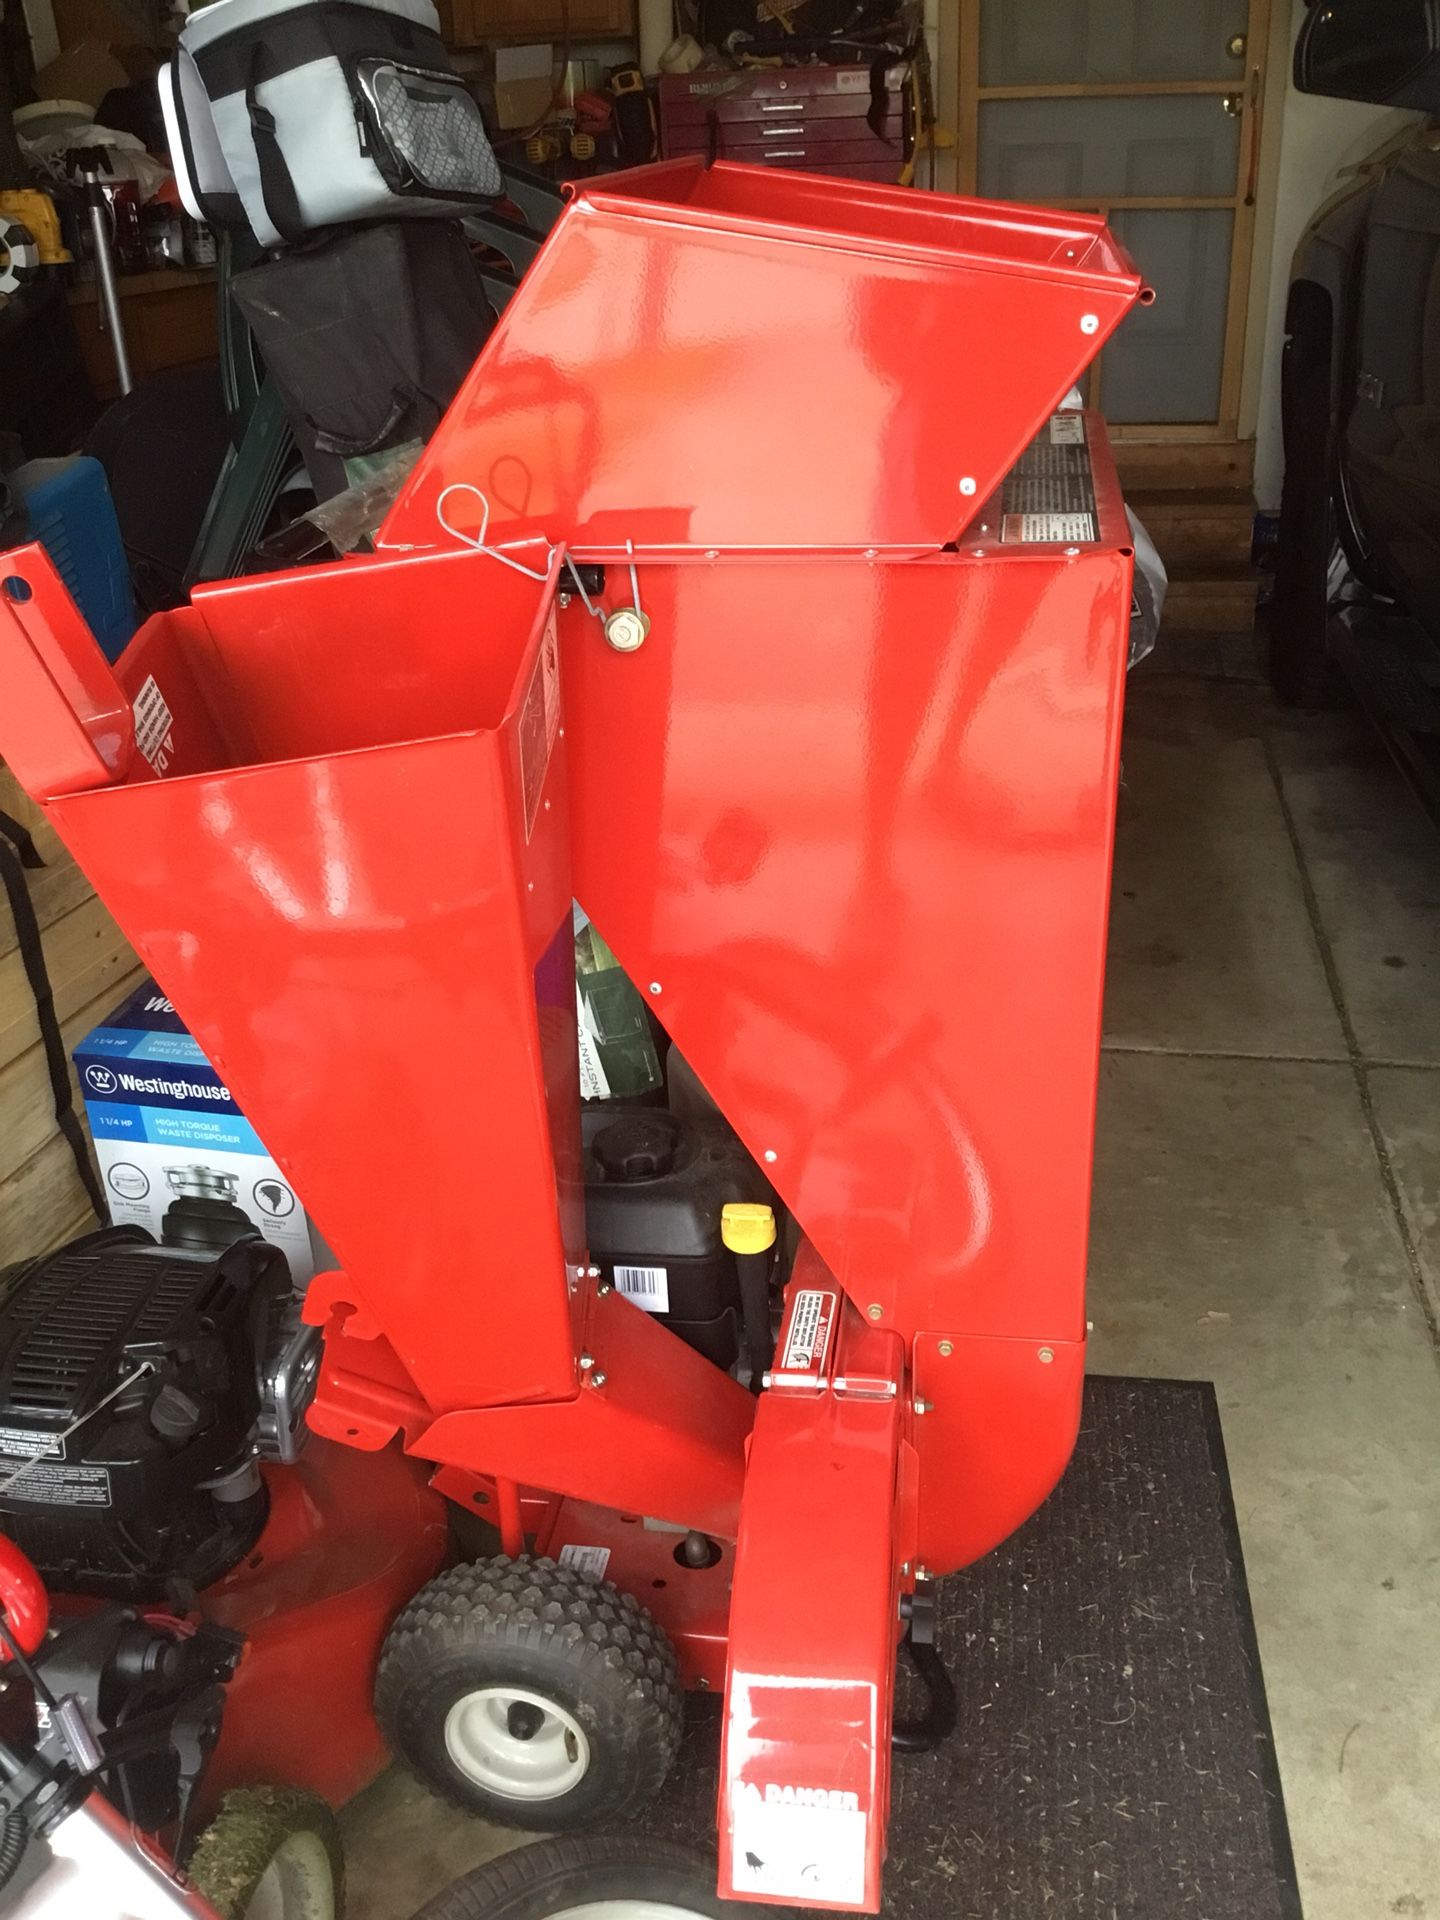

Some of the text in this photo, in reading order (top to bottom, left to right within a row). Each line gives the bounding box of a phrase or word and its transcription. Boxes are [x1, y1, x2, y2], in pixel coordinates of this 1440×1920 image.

[118, 1073, 231, 1101] Westinghouse
[105, 1117, 119, 1126] 1/4
[120, 1119, 133, 1128] HP
[155, 1117, 221, 1132] HIGH TORQUE
[157, 1127, 241, 1144] WASTE DISPOSER
[813, 1325, 827, 1358] DANGER
